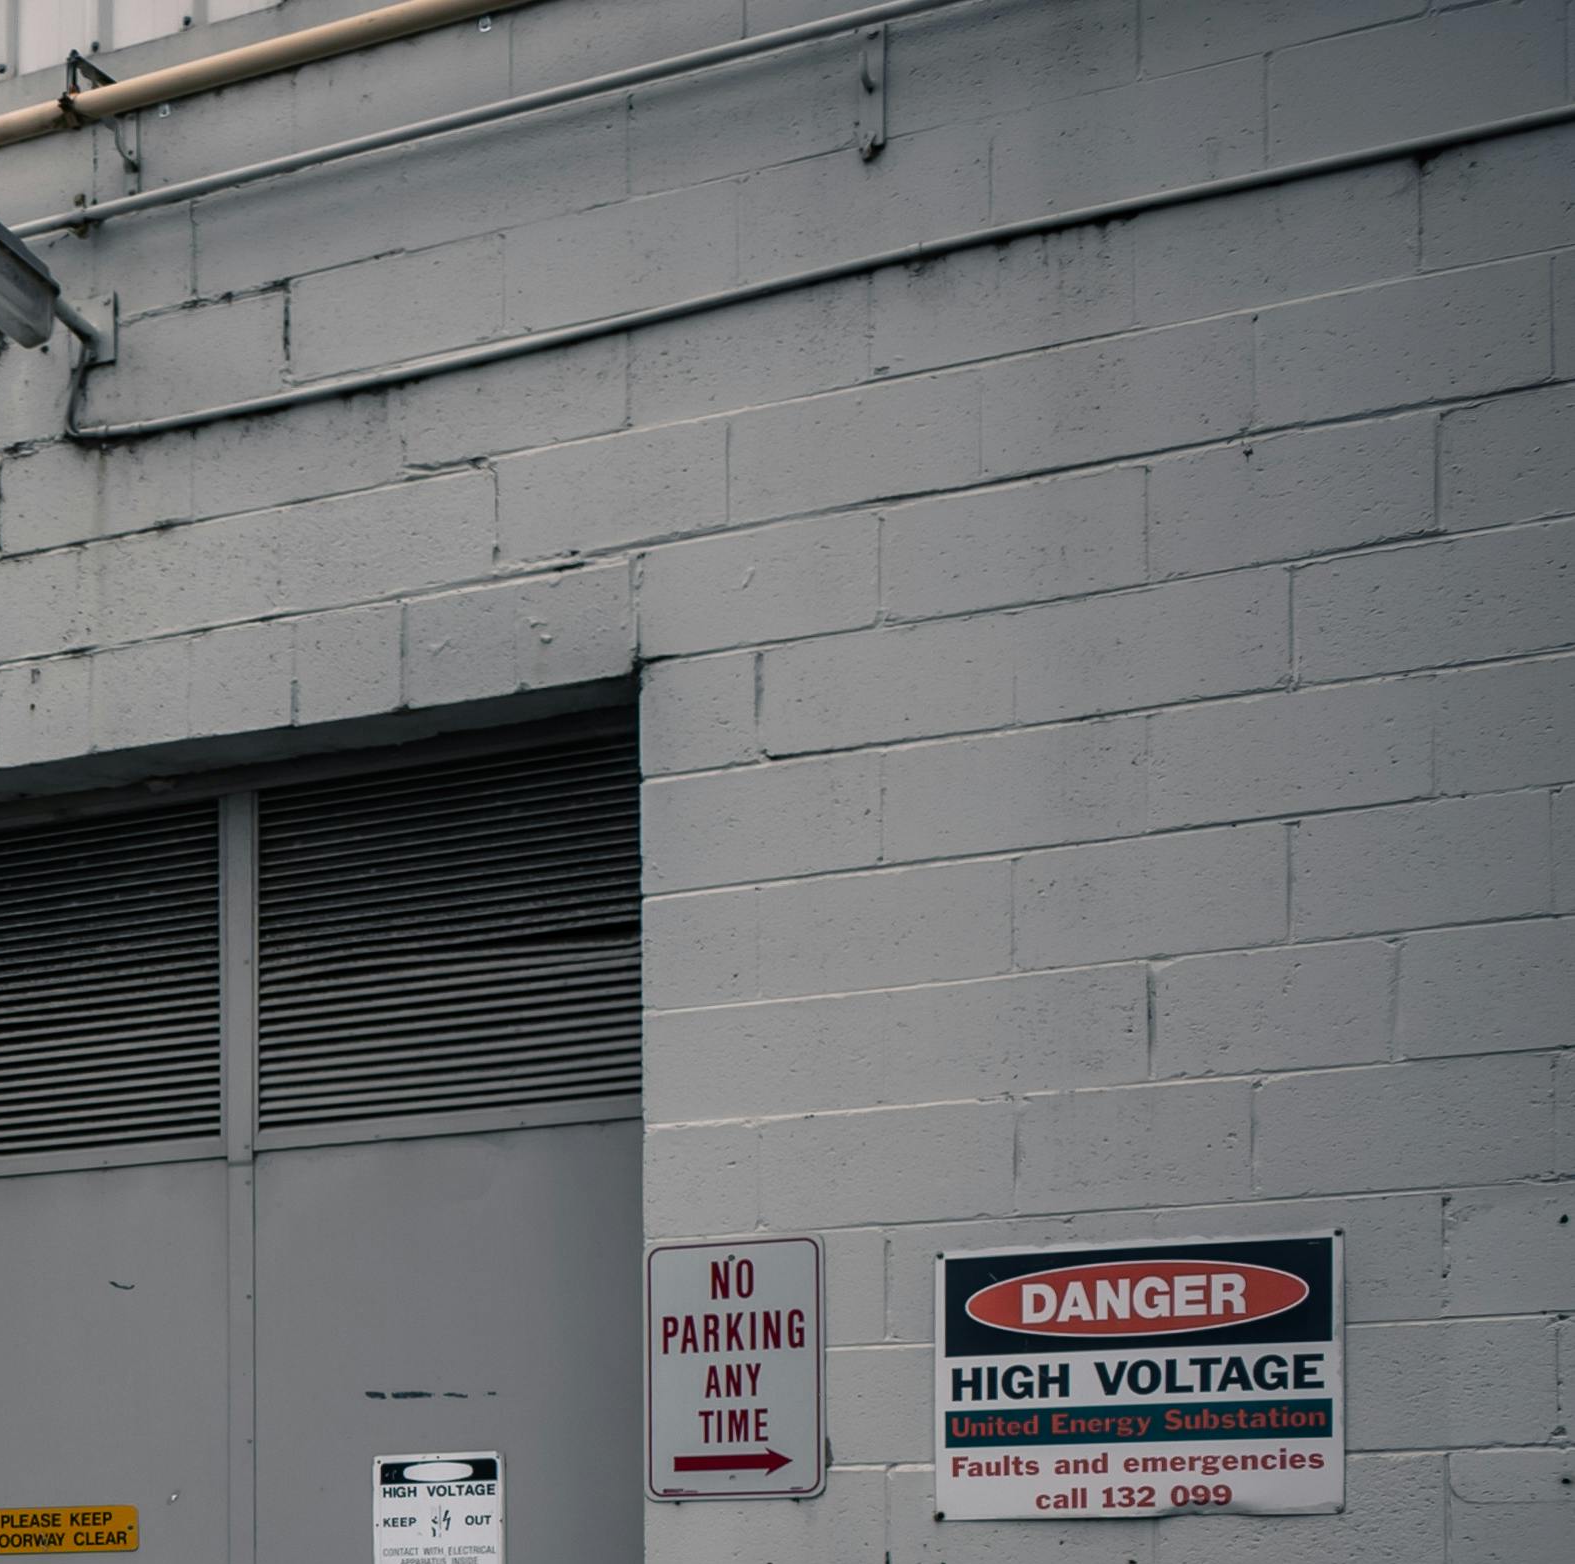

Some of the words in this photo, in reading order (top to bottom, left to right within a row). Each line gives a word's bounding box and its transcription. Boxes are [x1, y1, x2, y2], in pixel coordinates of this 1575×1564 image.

[711, 1258, 754, 1300] NO
[1020, 1272, 1248, 1325] DANGER
[662, 1308, 805, 1354] PARKING
[705, 1363, 762, 1398] ANY
[951, 1363, 1070, 1401] HIGH
[1093, 1353, 1325, 1396] VOLTAGE
[698, 1408, 769, 1444] TIME
[951, 1414, 1039, 1438] United
[1051, 1413, 1151, 1437] Energy
[1164, 1406, 1327, 1431] Substation
[951, 1454, 1040, 1478] Faults
[1054, 1452, 1109, 1475] and
[1123, 1448, 1325, 1477] emergencies
[382, 1486, 417, 1498] HIGH
[427, 1484, 496, 1497] VOLTAGE
[1035, 1487, 1087, 1510] call
[1101, 1485, 1156, 1508] 132
[1170, 1484, 1233, 1508] 099
[1, 1513, 61, 1529] PLEASE
[70, 1512, 113, 1526] KEEP
[383, 1517, 417, 1527] KEEP
[465, 1515, 492, 1525] OUT
[73, 1531, 127, 1546] CLEAR
[382, 1547, 419, 1556] CONTACT
[423, 1546, 444, 1555] WITH
[448, 1545, 496, 1556] ELECTRICAL
